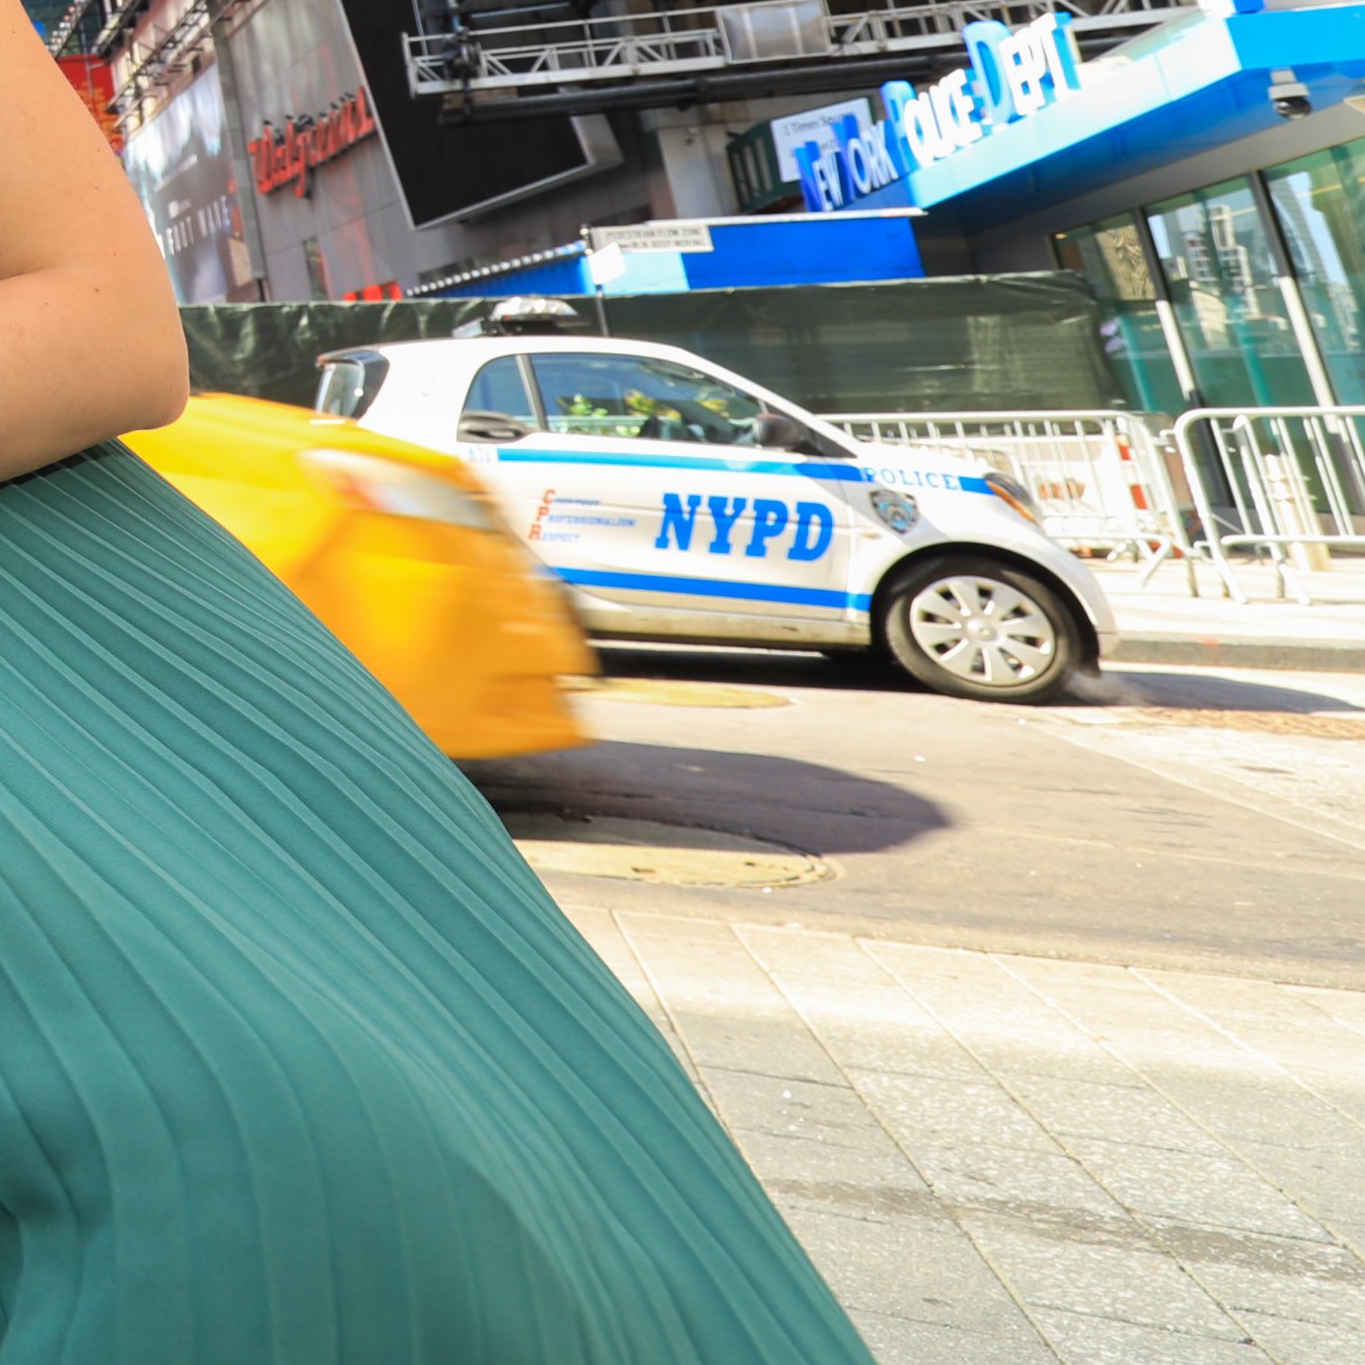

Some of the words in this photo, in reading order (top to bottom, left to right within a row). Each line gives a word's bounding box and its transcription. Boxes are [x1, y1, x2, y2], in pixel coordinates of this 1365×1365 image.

[833, 115, 903, 201] YORK
[862, 467, 962, 491] POLICE
[655, 492, 834, 562] NYPD
